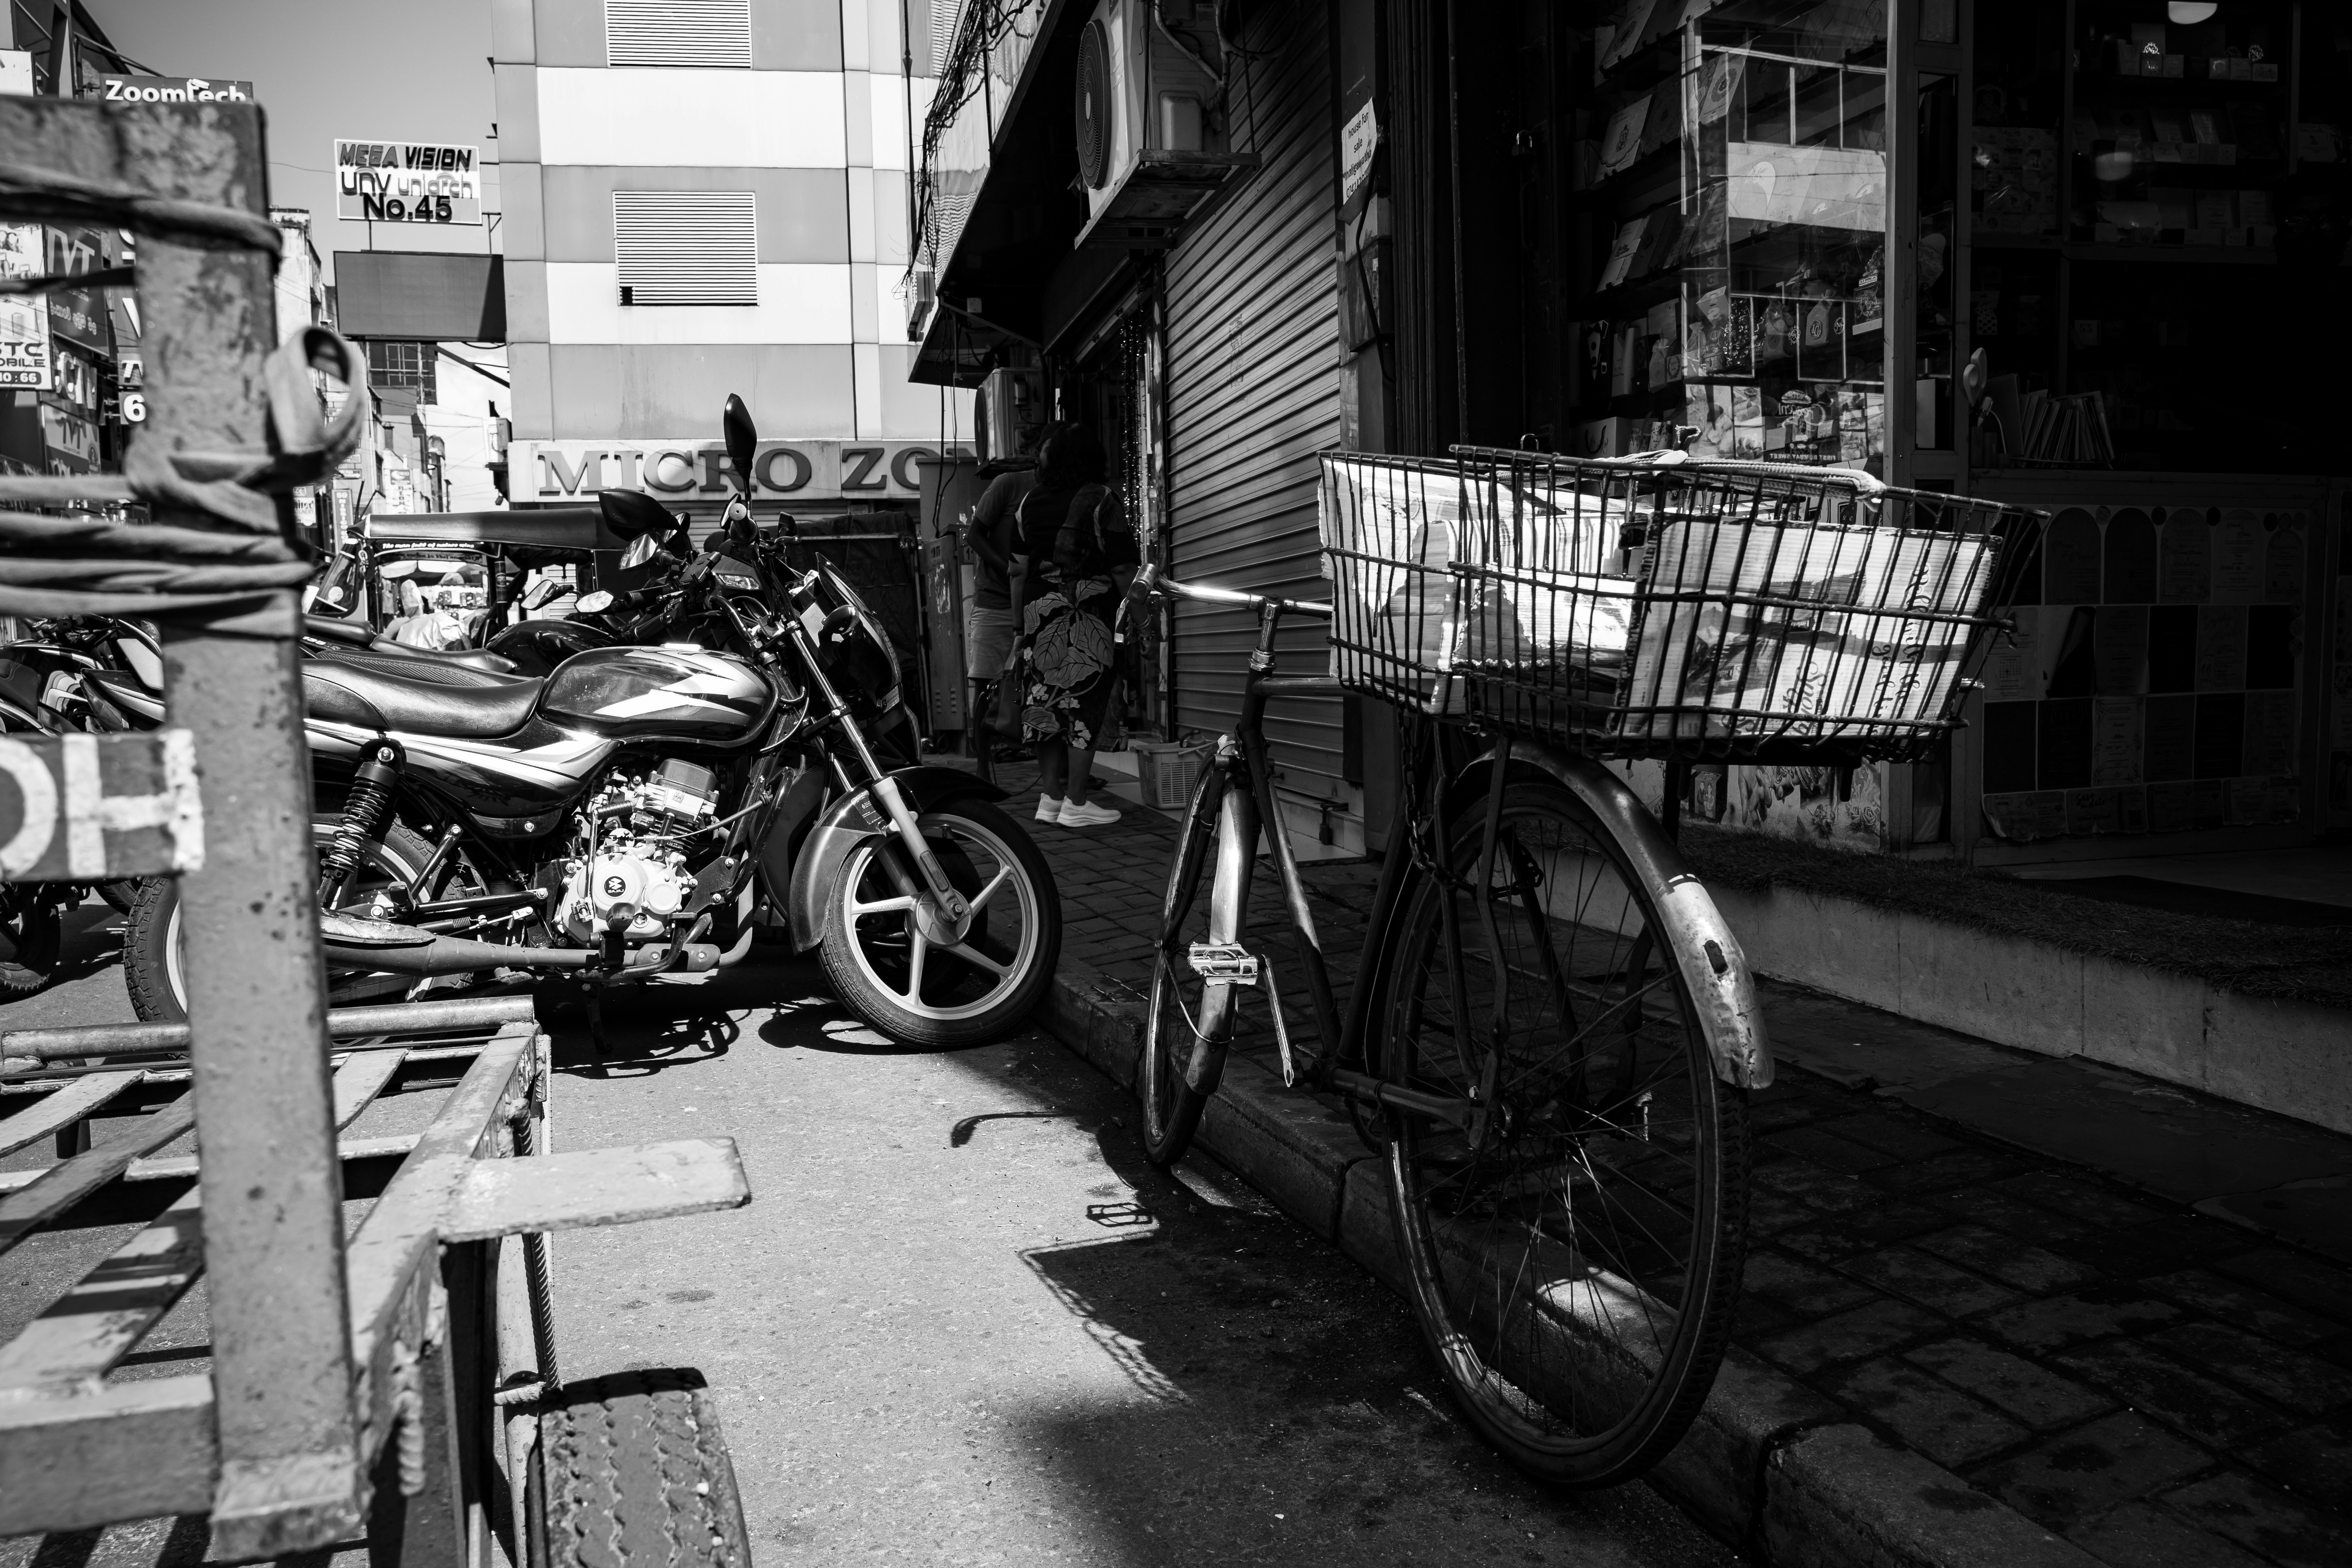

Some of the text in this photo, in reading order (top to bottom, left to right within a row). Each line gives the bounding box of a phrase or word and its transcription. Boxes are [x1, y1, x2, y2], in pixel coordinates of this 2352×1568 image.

[105, 78, 246, 102] Zoomtech
[1348, 120, 1361, 139] house
[340, 143, 472, 172] MEGA VISION
[1354, 138, 1363, 153] sale
[363, 192, 452, 221] No.45
[537, 447, 975, 495] MICRO ZO
